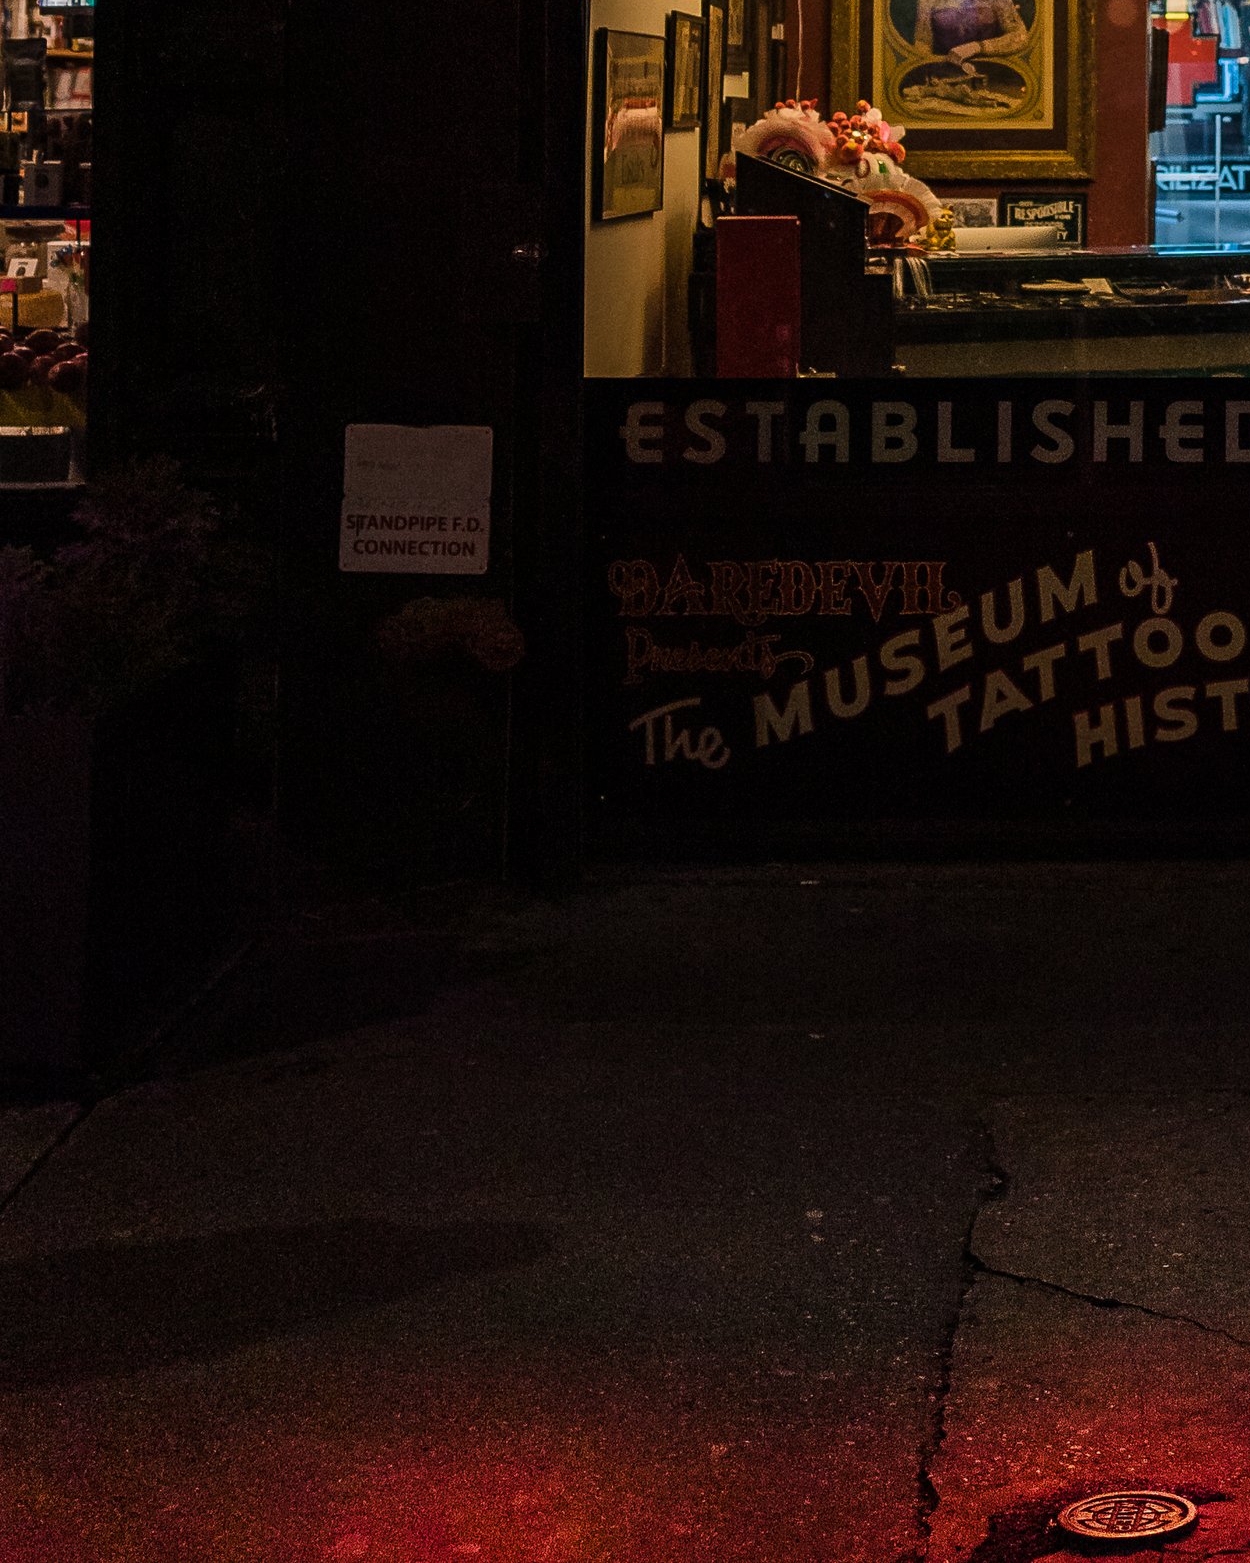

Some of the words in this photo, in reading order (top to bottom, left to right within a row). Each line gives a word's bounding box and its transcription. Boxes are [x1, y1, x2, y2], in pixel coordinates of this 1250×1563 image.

[346, 514, 448, 532] STANDPIPE
[452, 516, 485, 533] F.D.
[353, 539, 476, 557] CONNECTION
[607, 552, 962, 626] DAREDEVIL
[628, 696, 733, 770] The
[753, 549, 1099, 749] MUSEUM
[1118, 541, 1179, 615] of
[926, 609, 1248, 755] TATTOO
